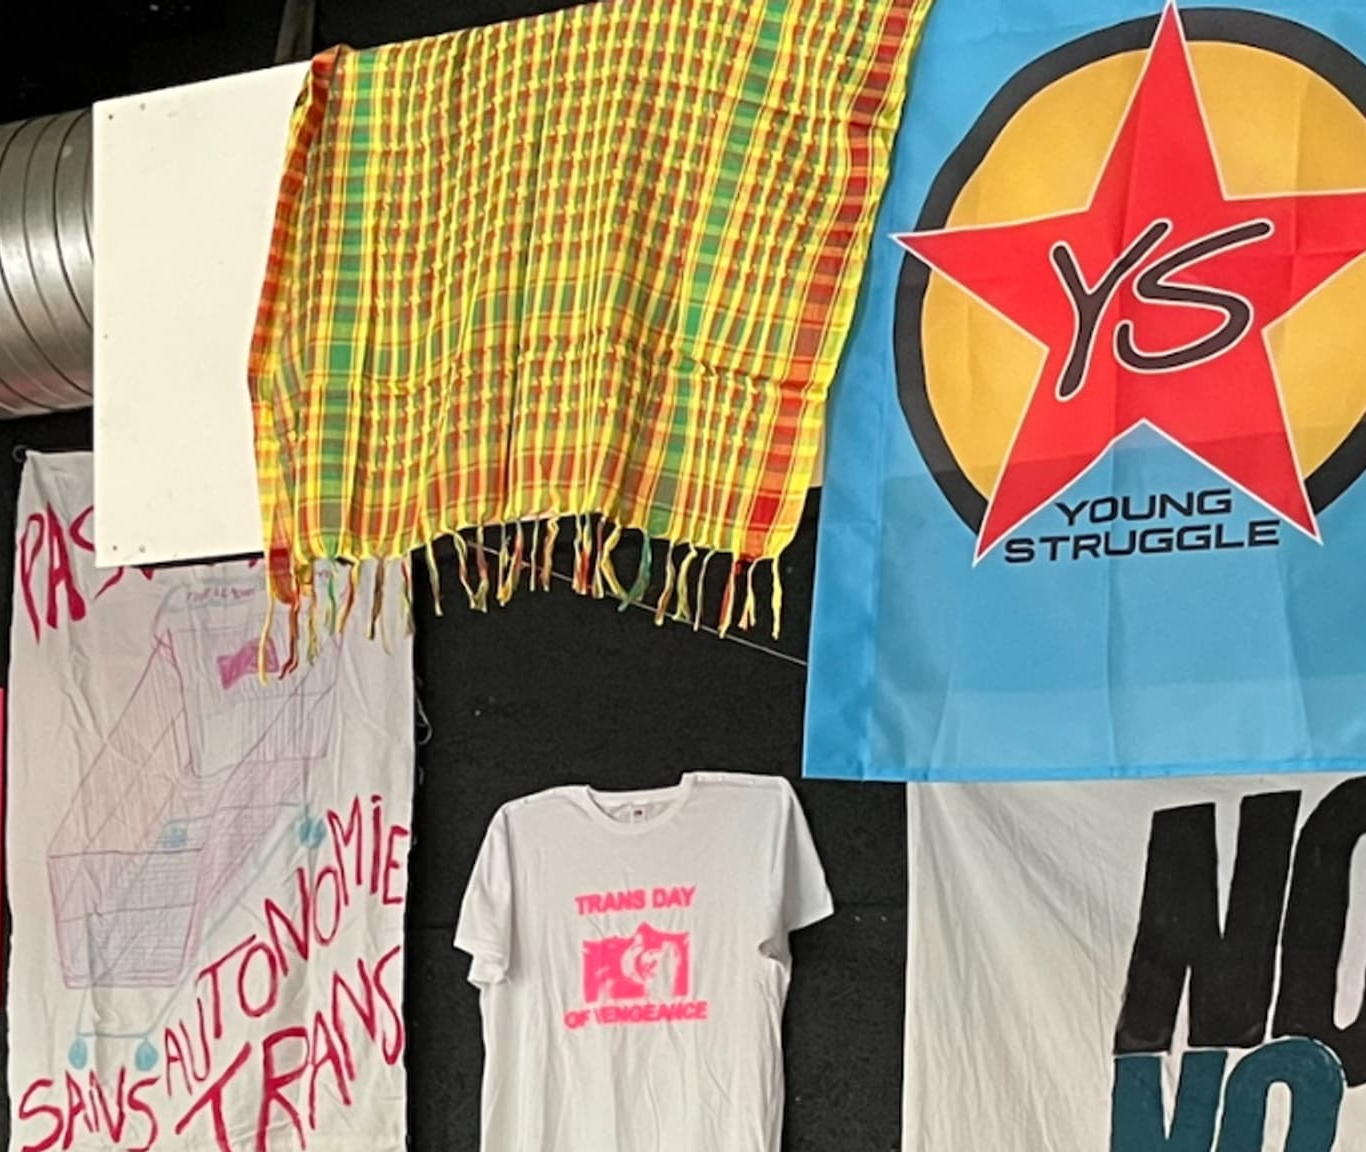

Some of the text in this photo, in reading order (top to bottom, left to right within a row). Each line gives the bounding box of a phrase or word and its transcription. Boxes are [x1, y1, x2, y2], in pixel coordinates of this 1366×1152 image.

[1049, 218, 1274, 402] YS
[1055, 488, 1232, 526] YOUNG
[1003, 519, 1281, 564] STRUGGLE
[575, 886, 695, 915] TRANS DAY
[165, 796, 410, 1096] AUTONOMIE
[564, 1001, 707, 1029] OF VENGEANCE
